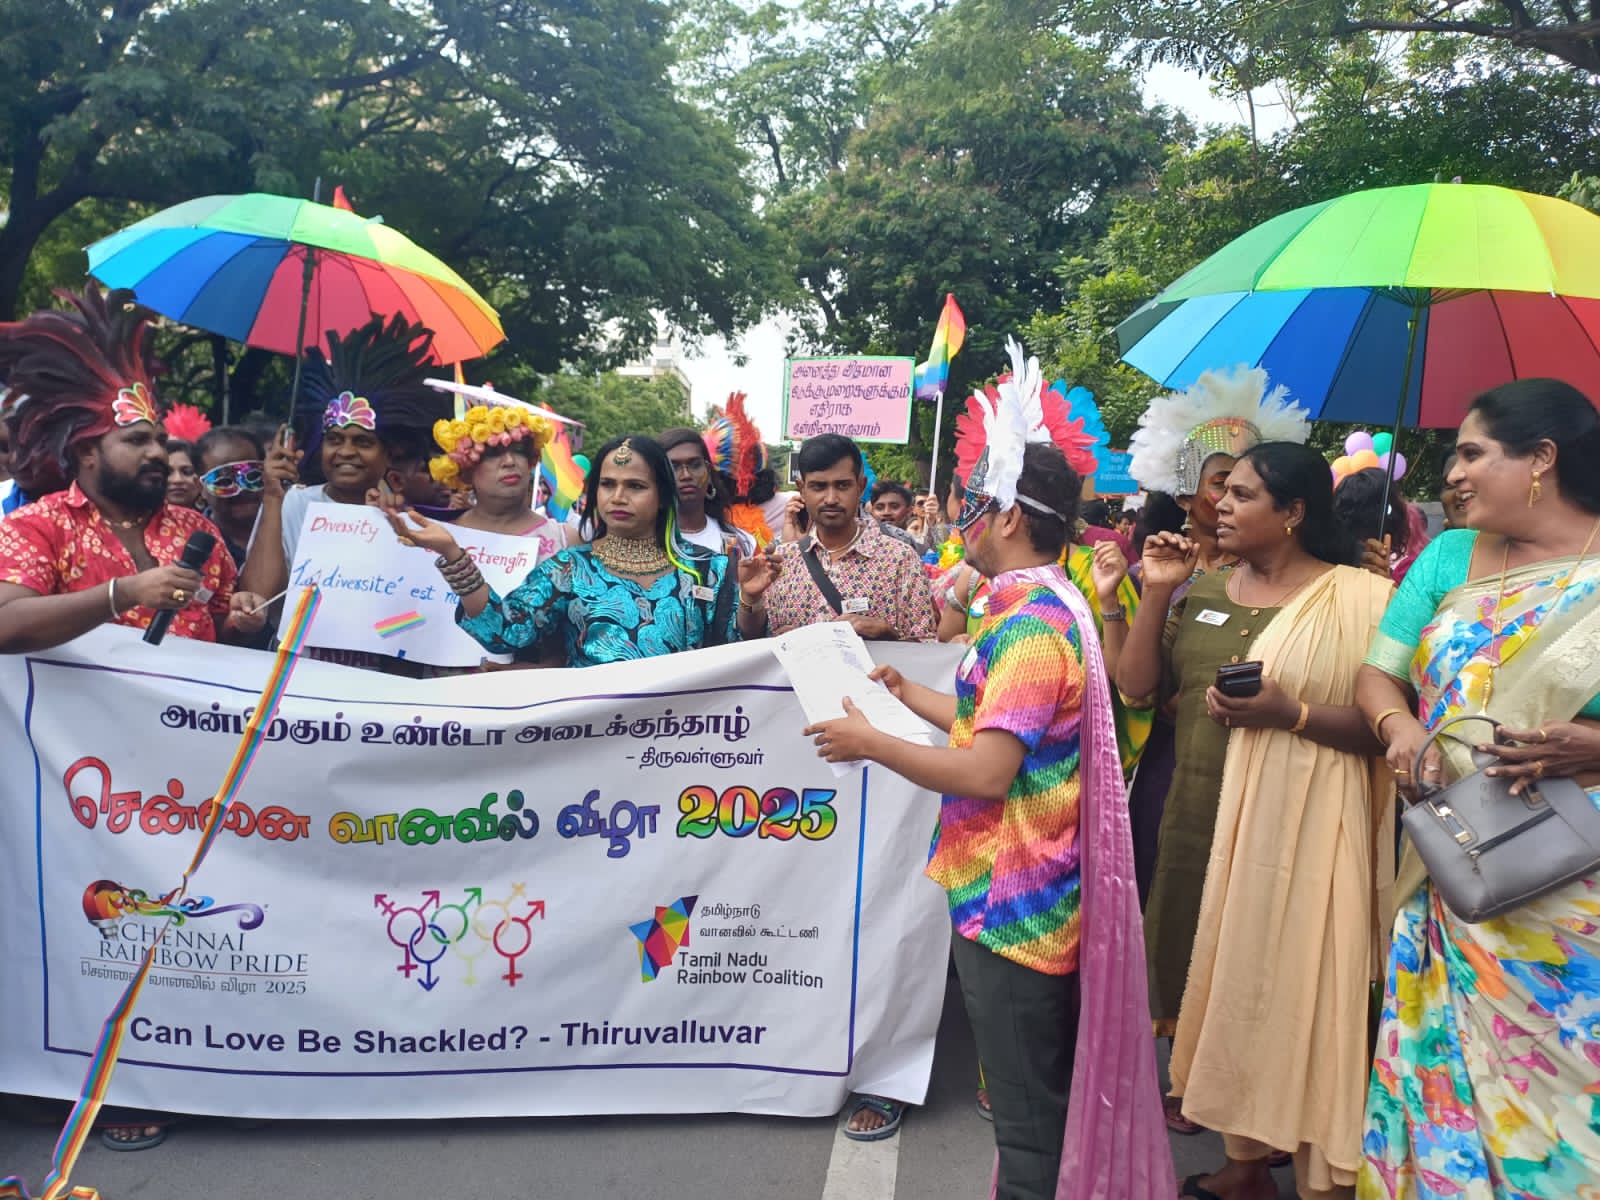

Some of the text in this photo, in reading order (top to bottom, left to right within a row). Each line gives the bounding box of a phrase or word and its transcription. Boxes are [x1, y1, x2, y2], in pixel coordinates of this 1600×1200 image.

[310, 516, 380, 543] Diversity
[410, 585, 436, 600] est
[360, 712, 505, 747] உண்டோ
[514, 705, 750, 743] அடைக்குந்தாழ்
[639, 747, 765, 769] திருவள்ளுவர்
[329, 789, 539, 845] வானவில்
[557, 789, 660, 859] விழா
[676, 785, 837, 842] 2025
[701, 903, 761, 919] தமிழ்நாடு
[121, 922, 247, 952] CHENNAI
[699, 924, 819, 939] வானவில் கூட்டணி
[100, 940, 308, 973] RAINBOW PRIDE
[679, 951, 768, 967] Tamil Nadu
[149, 974, 216, 991] வானவில்
[221, 976, 256, 995] விழா
[265, 981, 307, 995] 2025
[677, 969, 824, 989] Rainbow Coalition
[130, 1017, 192, 1046] Can
[205, 1024, 285, 1051] Love
[298, 1029, 341, 1053] Be
[353, 1025, 528, 1053] Shackled?
[560, 1020, 767, 1046] Thiruvalluvar
